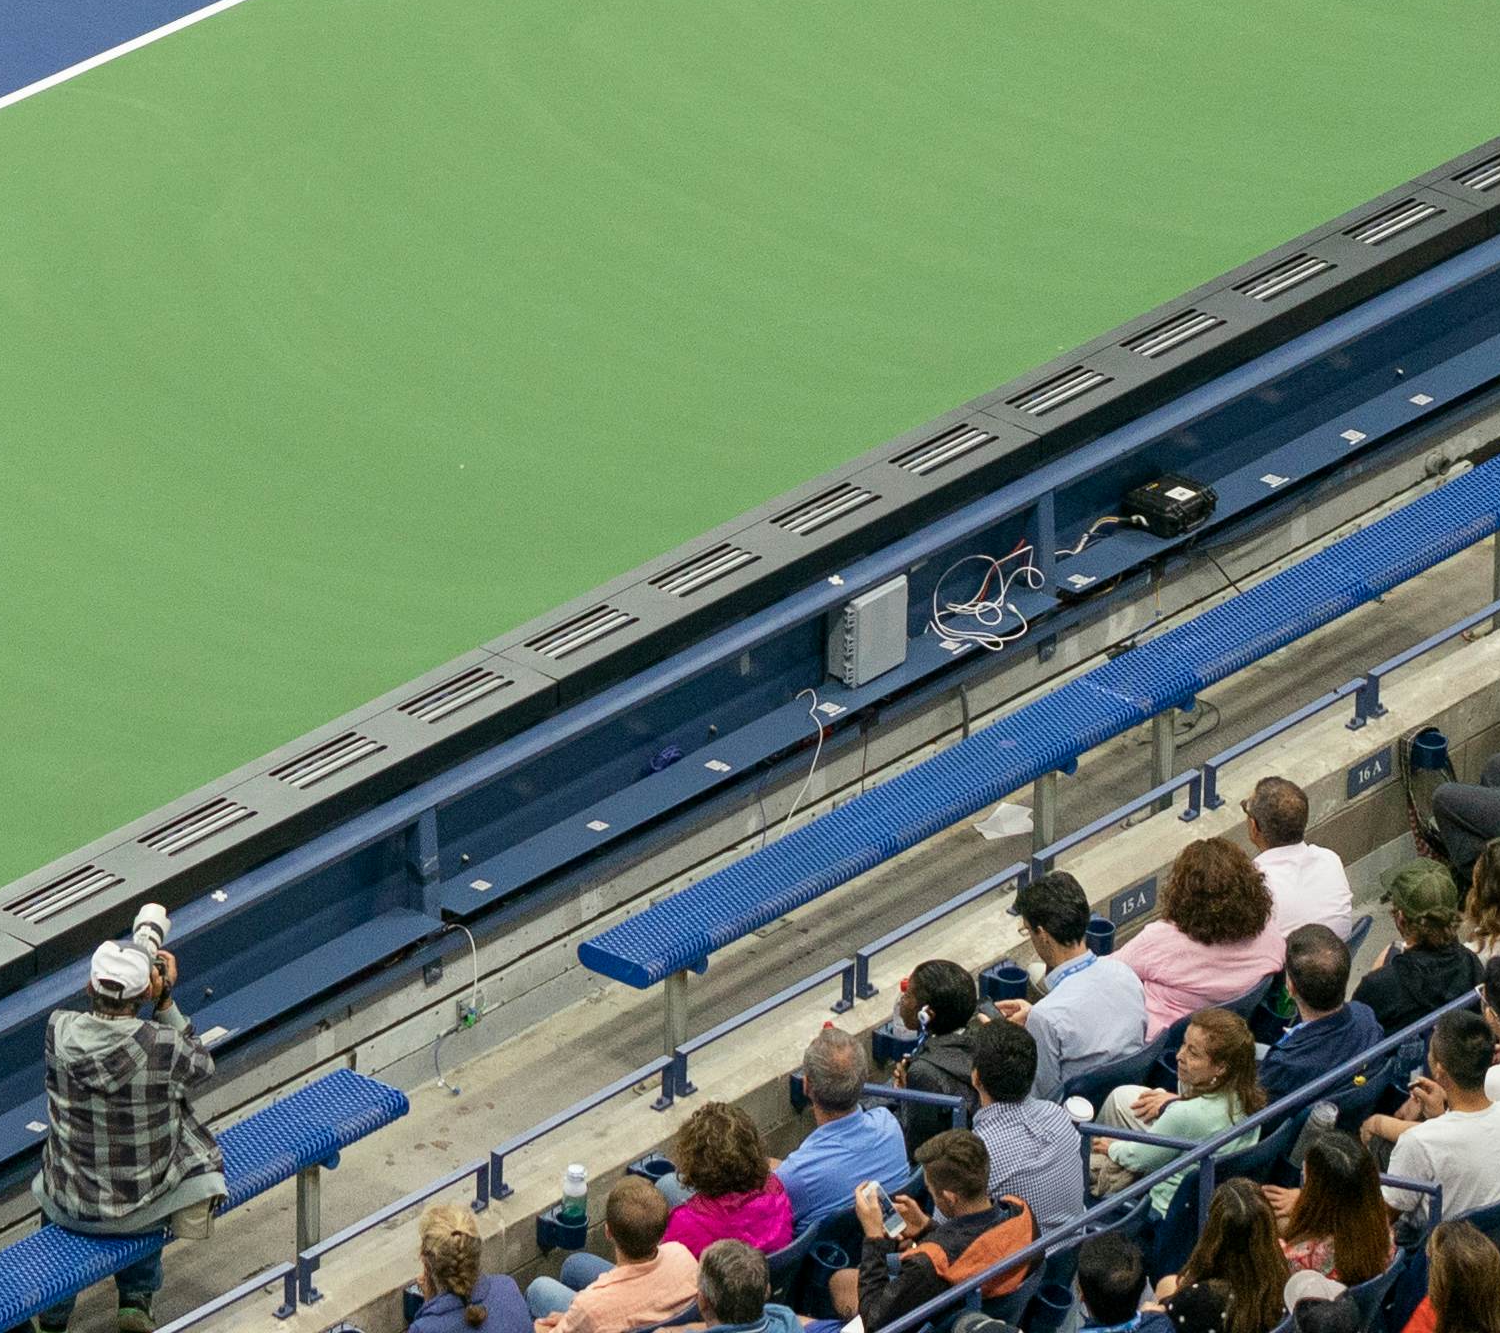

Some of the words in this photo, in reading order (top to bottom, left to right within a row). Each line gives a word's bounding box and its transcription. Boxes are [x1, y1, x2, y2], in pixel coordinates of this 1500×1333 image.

[1359, 768, 1371, 783] 16
[1372, 760, 1382, 774] A
[1122, 898, 1135, 915] 15
[1137, 891, 1147, 904] A
